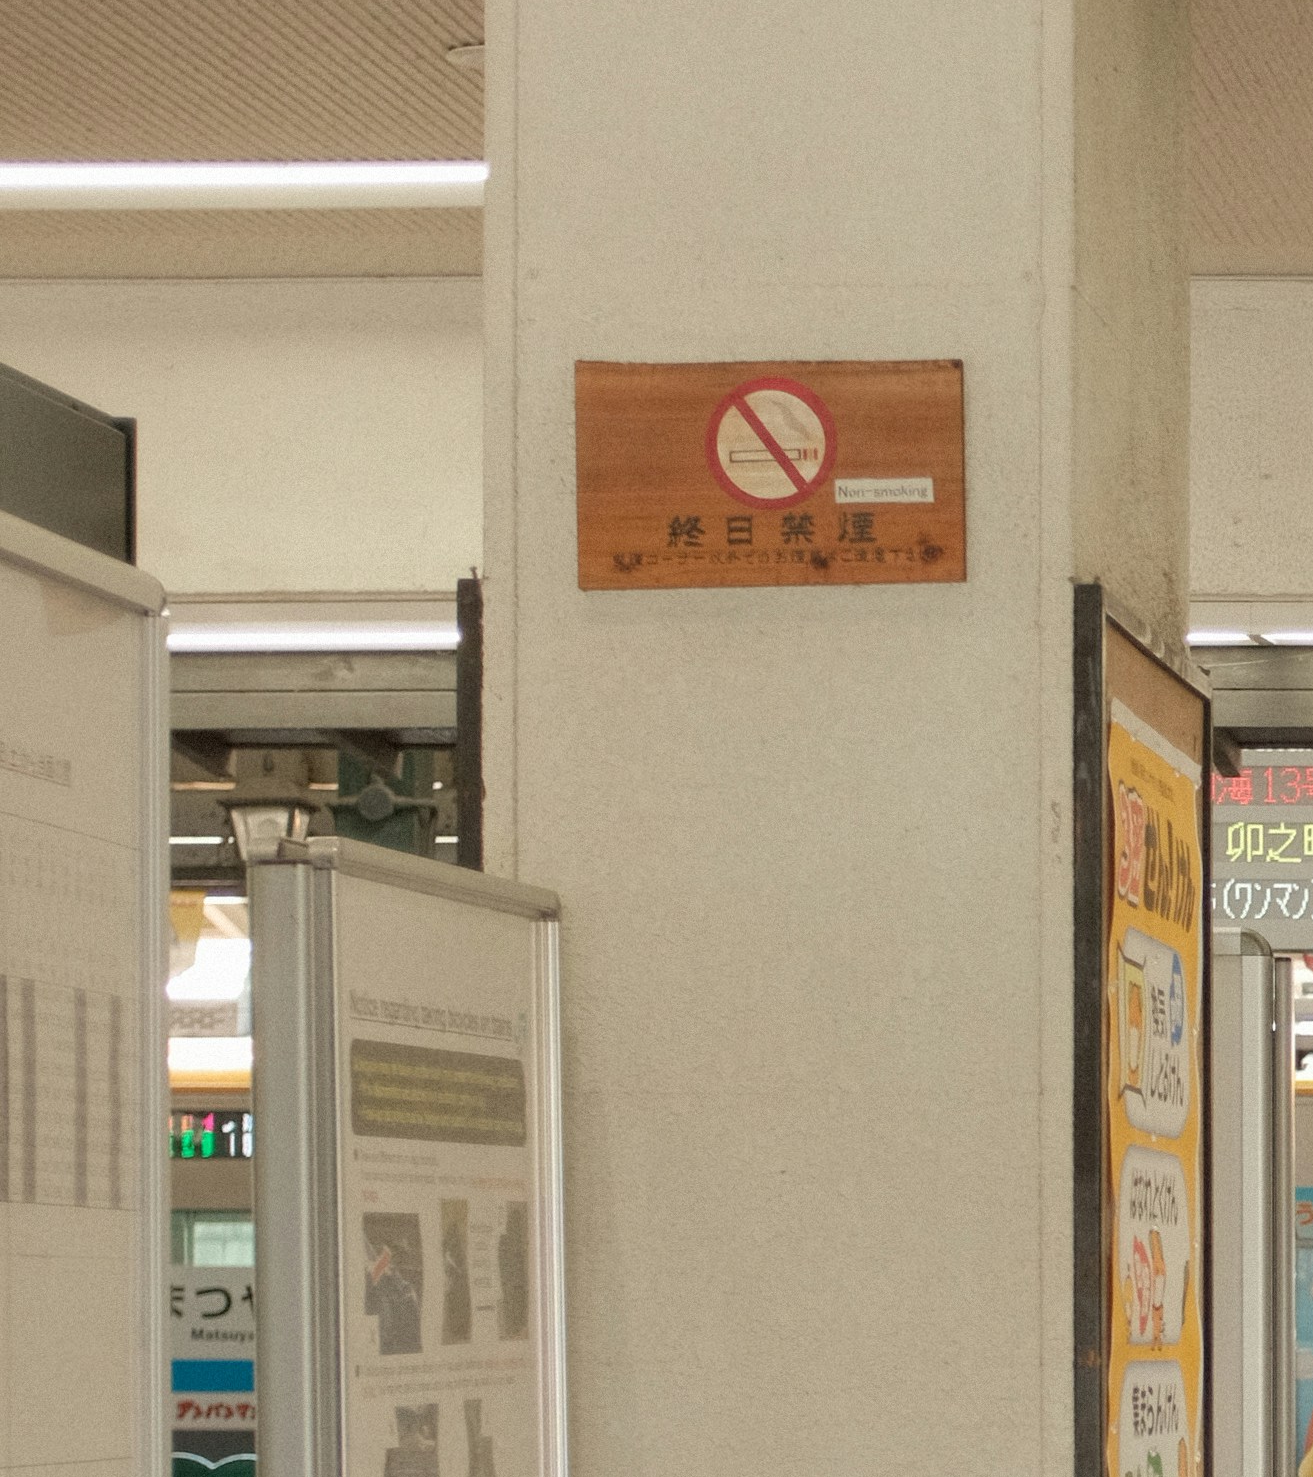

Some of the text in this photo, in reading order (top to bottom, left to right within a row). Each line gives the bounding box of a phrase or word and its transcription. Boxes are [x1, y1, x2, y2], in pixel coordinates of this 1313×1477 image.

[837, 484, 929, 500] Non-smoking
[667, 511, 876, 548] 終日禁煙
